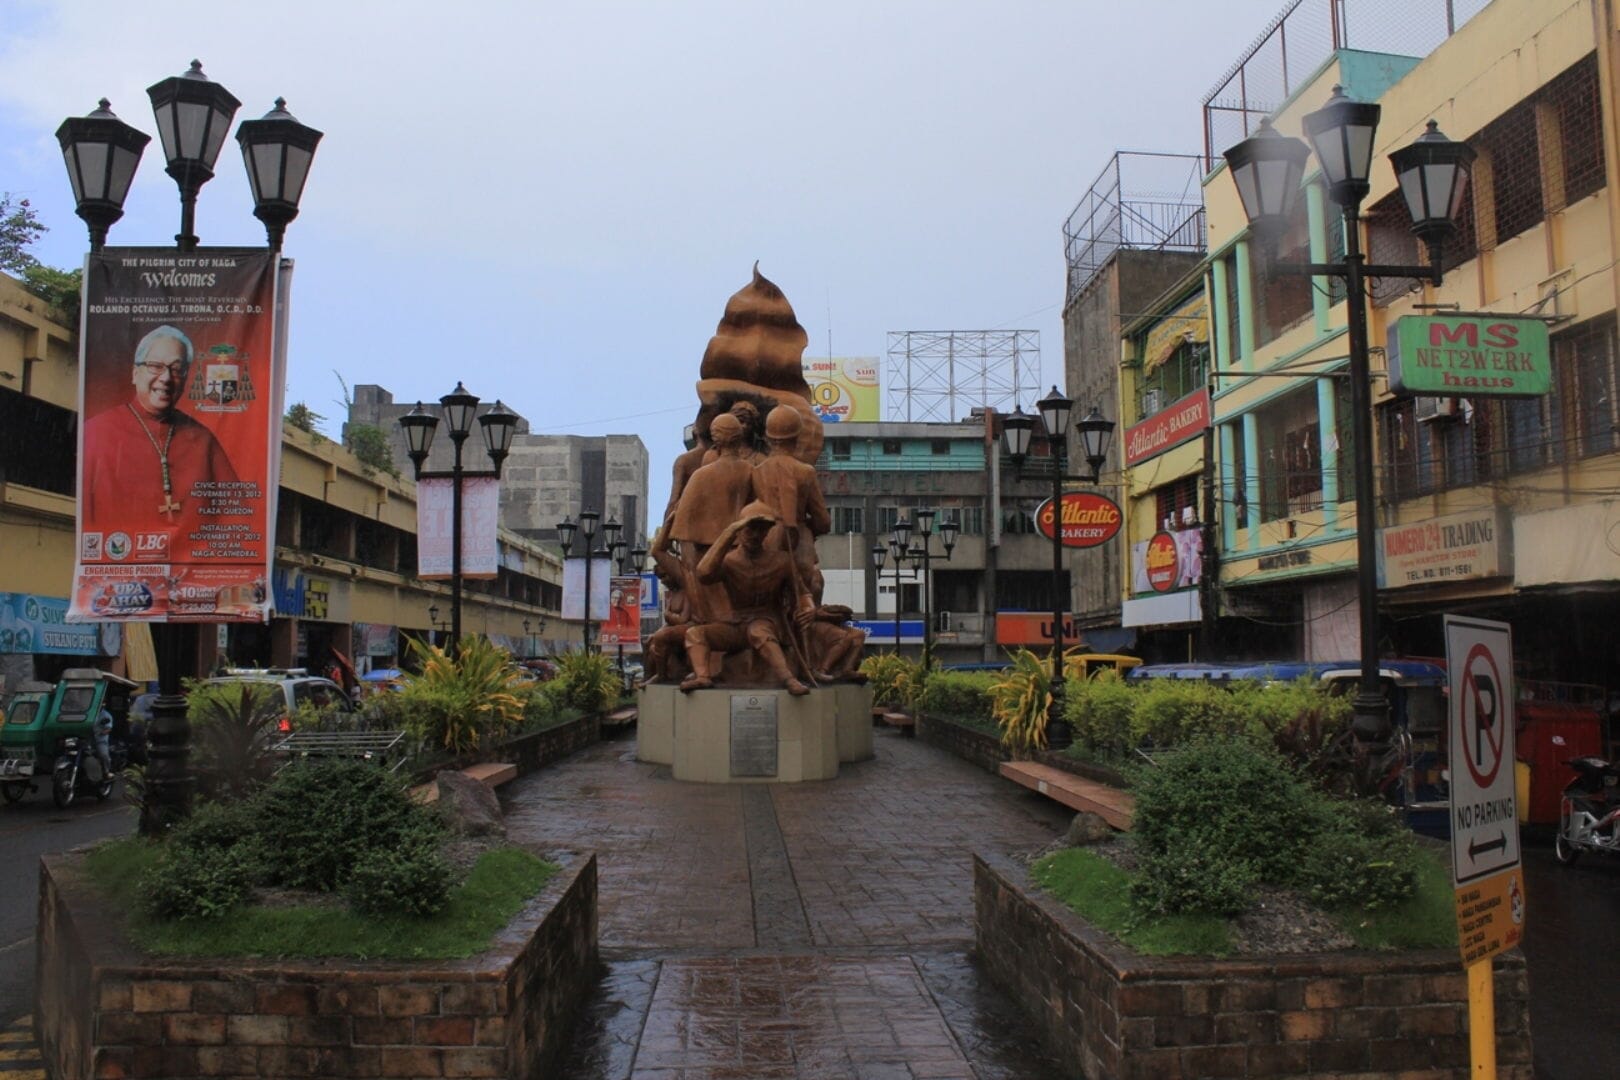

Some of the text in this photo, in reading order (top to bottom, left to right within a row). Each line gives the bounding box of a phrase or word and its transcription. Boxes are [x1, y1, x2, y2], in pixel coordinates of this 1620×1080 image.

[121, 258, 236, 267] THE PILGRIM CITY OF NAGA
[140, 268, 216, 288] Welcomes
[89, 305, 130, 313] ROLANDO
[132, 305, 169, 313] OCTAVUS
[171, 305, 178, 313] J.
[180, 305, 215, 314] TIRONA,
[1429, 322, 1519, 348] MS
[812, 362, 837, 371] SUN!
[1416, 348, 1536, 371] NET2WERK
[1442, 371, 1514, 387] haus
[1128, 402, 1203, 459] Atlantic BAKERY
[198, 507, 253, 515] PLAZA QUEZON
[136, 534, 168, 551] LBC
[1441, 518, 1493, 549] TRADING
[1457, 797, 1513, 831] NO PARKING
